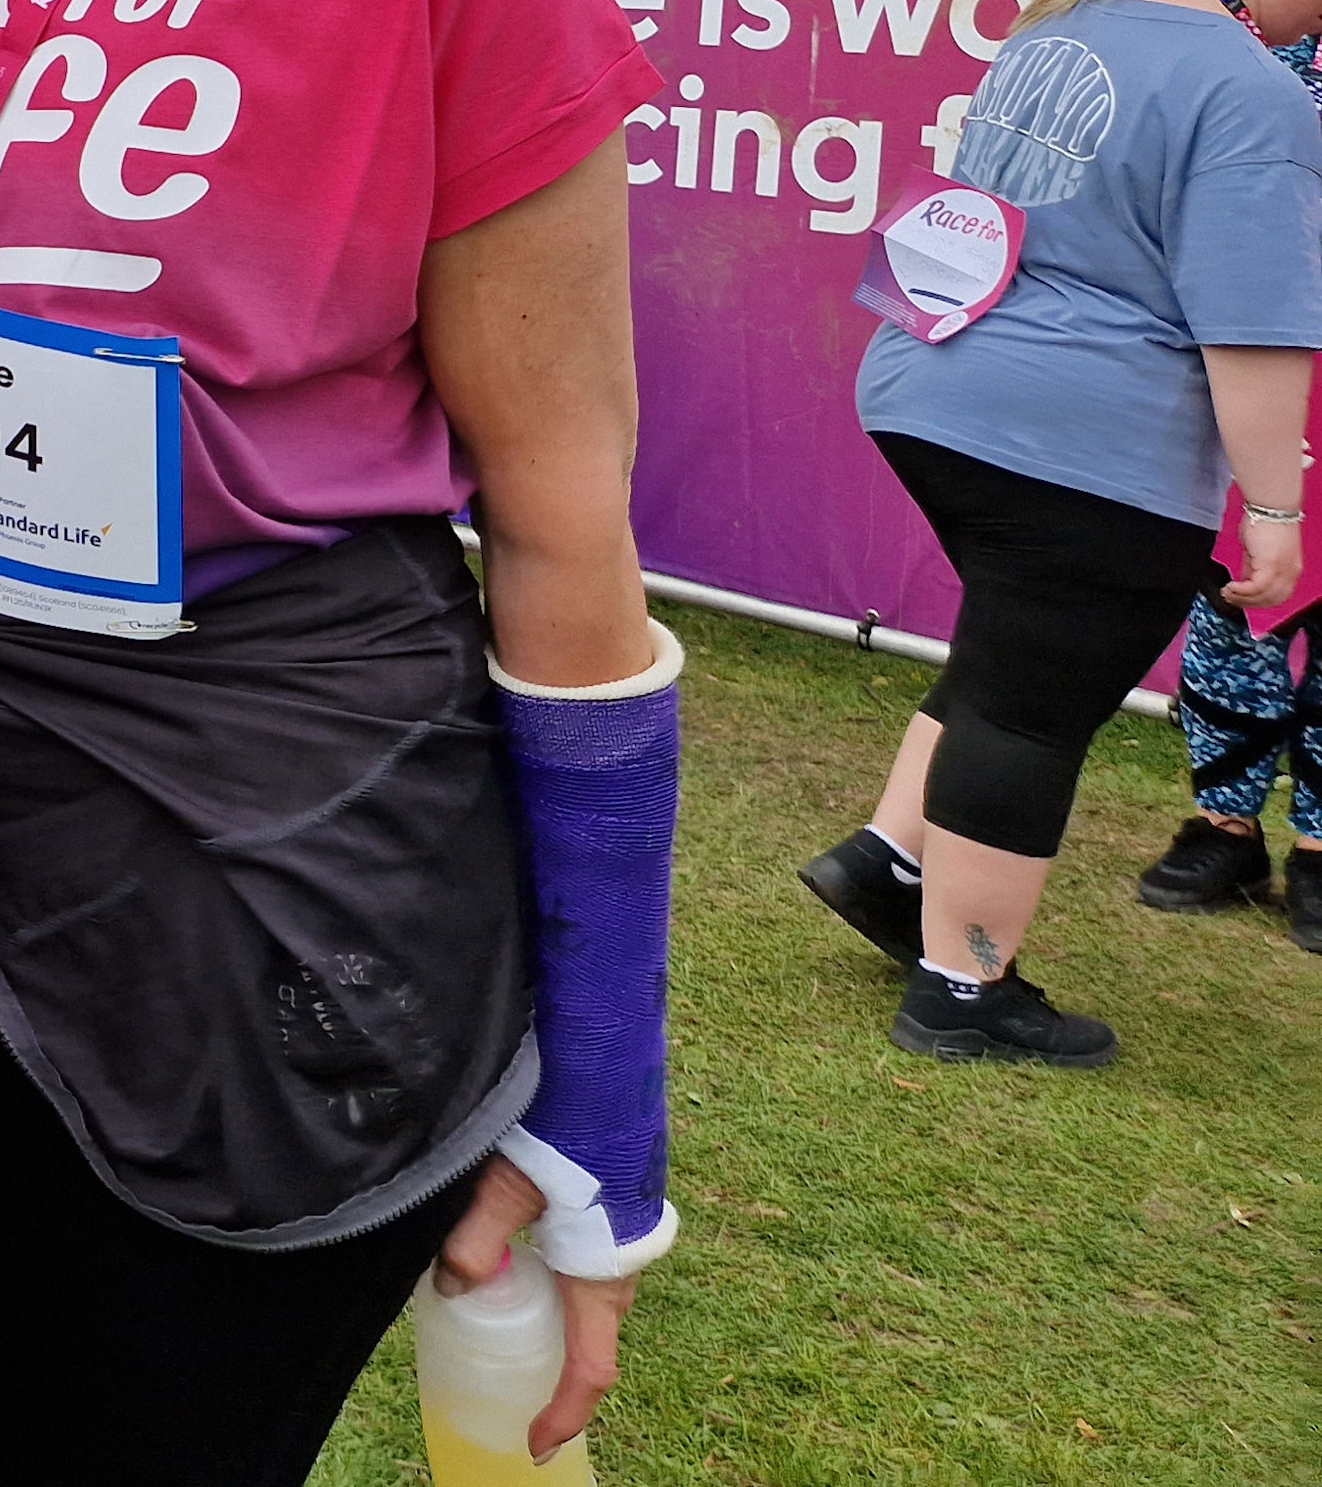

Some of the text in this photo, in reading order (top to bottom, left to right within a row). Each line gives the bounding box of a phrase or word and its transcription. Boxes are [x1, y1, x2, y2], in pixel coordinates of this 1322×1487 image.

[625, 73, 884, 235] cing
[920, 199, 1005, 243] Race for
[63, 526, 102, 548] Life
